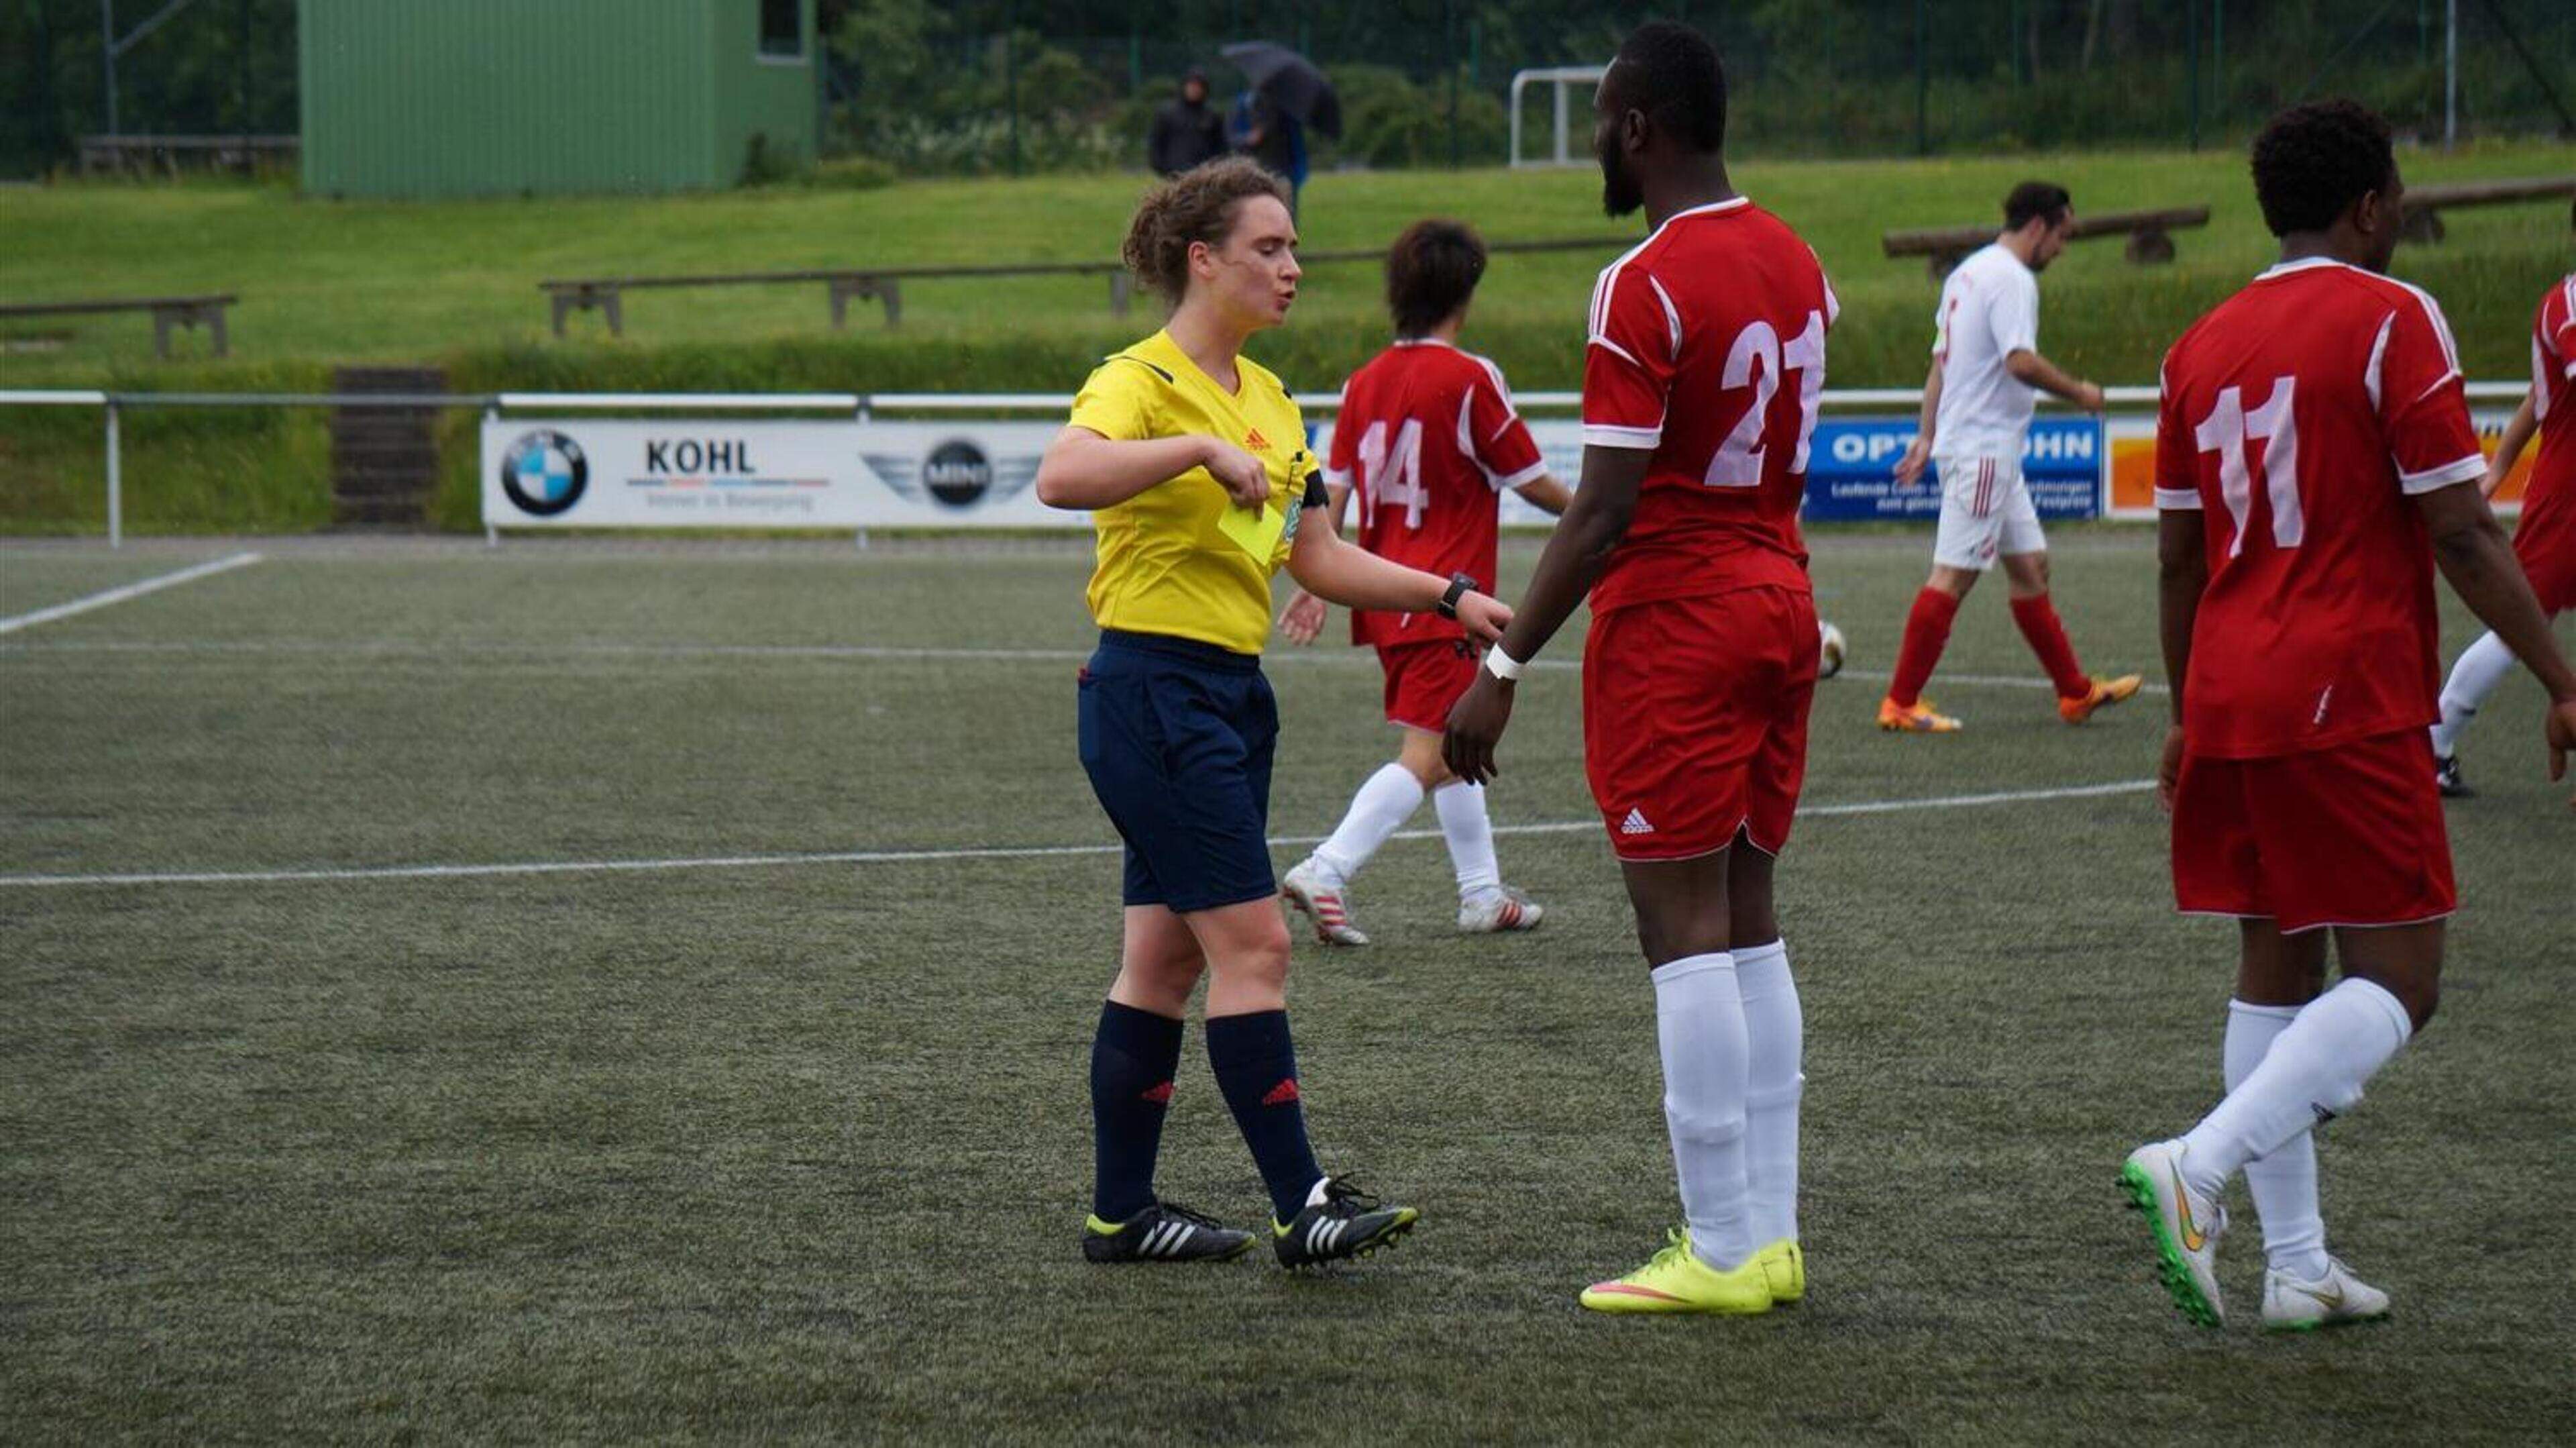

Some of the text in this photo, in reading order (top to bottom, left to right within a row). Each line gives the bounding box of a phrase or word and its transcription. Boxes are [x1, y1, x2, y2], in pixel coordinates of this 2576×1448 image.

[647, 439, 756, 473] KOHL
[1704, 310, 1825, 487] 21
[2196, 376, 2304, 558] 11
[1358, 417, 1429, 529] 14
